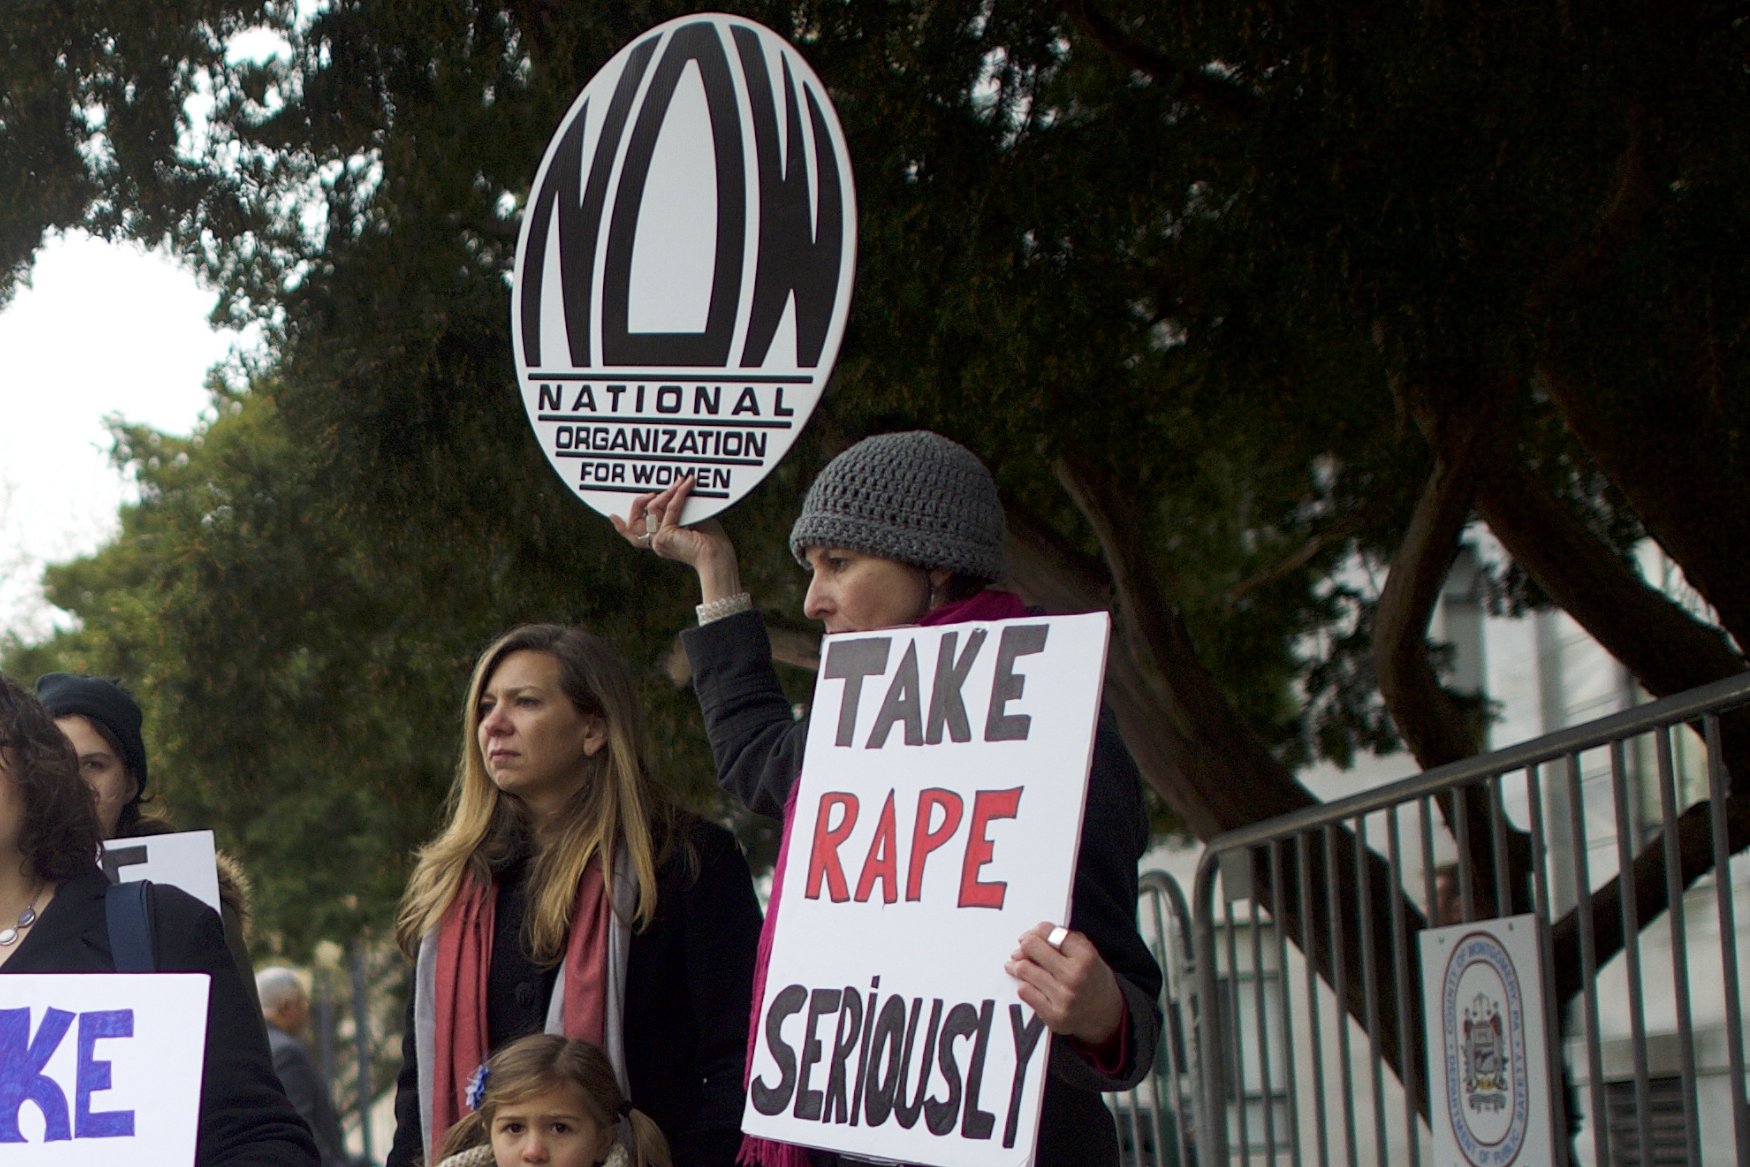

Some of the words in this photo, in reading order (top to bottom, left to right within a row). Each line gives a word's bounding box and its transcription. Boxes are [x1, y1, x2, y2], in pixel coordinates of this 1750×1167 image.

[521, 21, 843, 368] NOW
[538, 384, 795, 417] NATIONAL
[555, 426, 767, 458] ORGANIZATION
[580, 462, 626, 484] FOR
[631, 463, 732, 489] WOMEN
[823, 623, 1050, 749] TAKE
[804, 785, 1025, 911] RAPE
